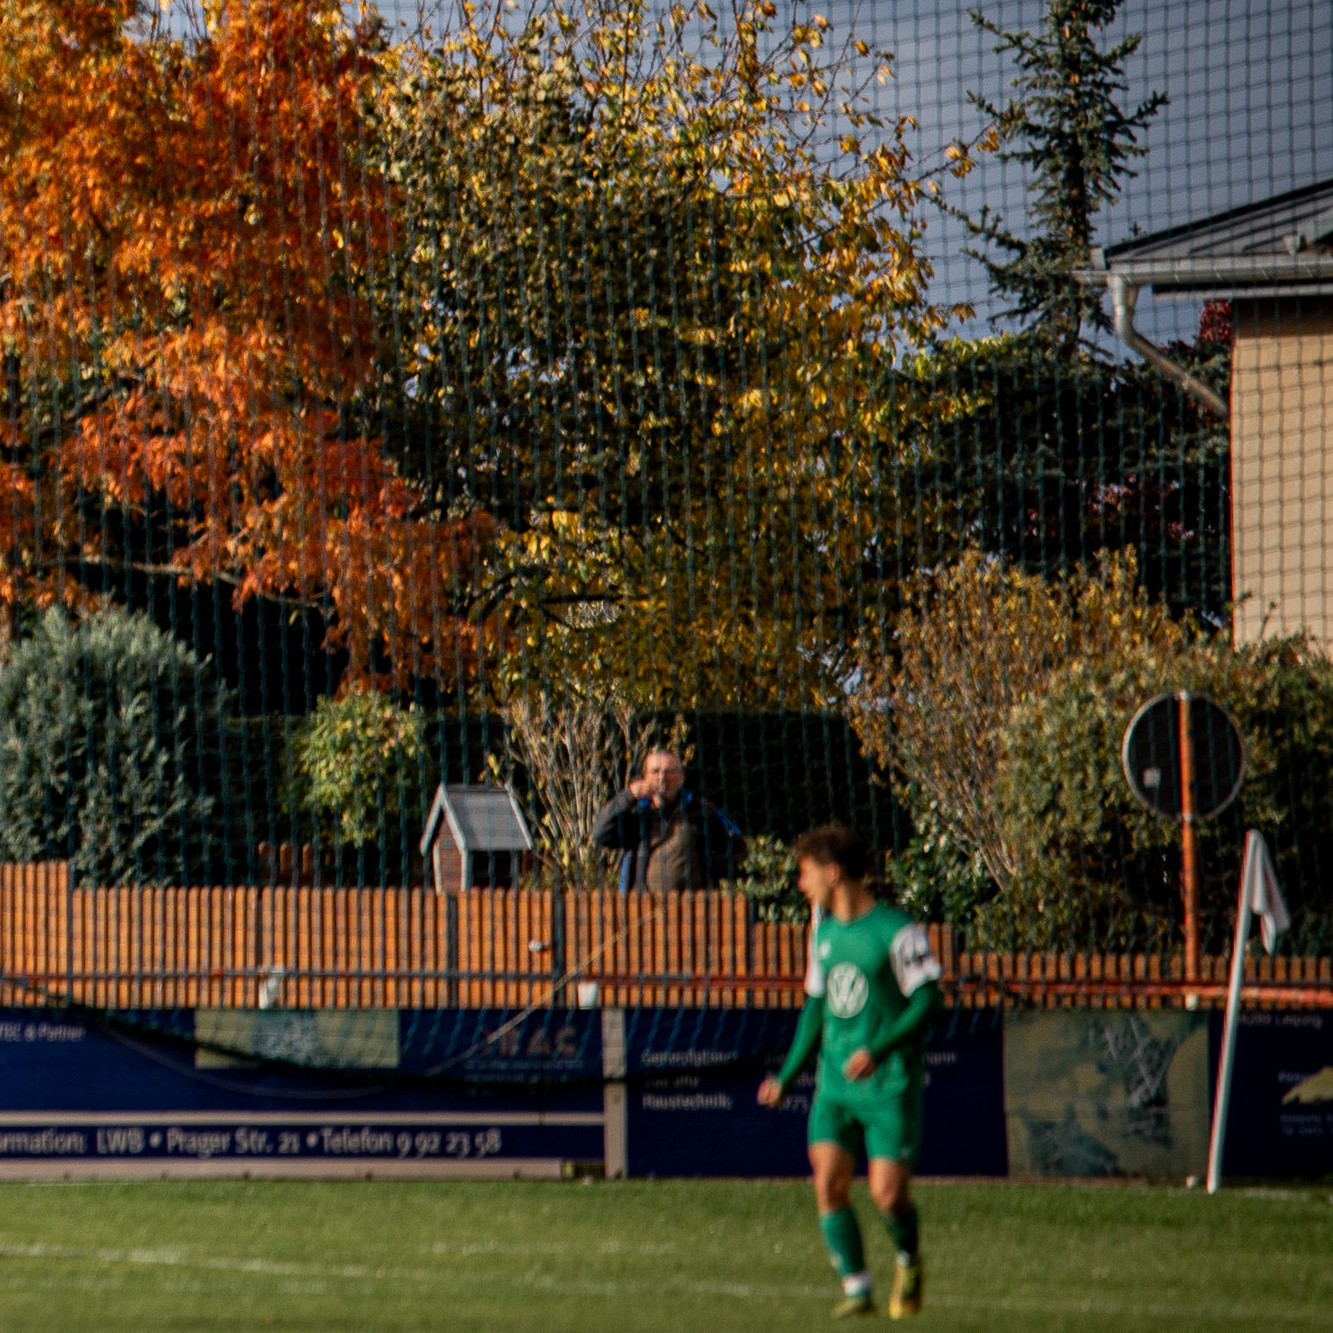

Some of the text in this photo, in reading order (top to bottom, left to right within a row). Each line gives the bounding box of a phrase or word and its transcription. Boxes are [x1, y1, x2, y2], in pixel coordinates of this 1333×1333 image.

[96, 1129, 144, 1154] LWB
[166, 1129, 231, 1159] Prager
[234, 1129, 273, 1154] Str.
[319, 1128, 392, 1153] Telefon
